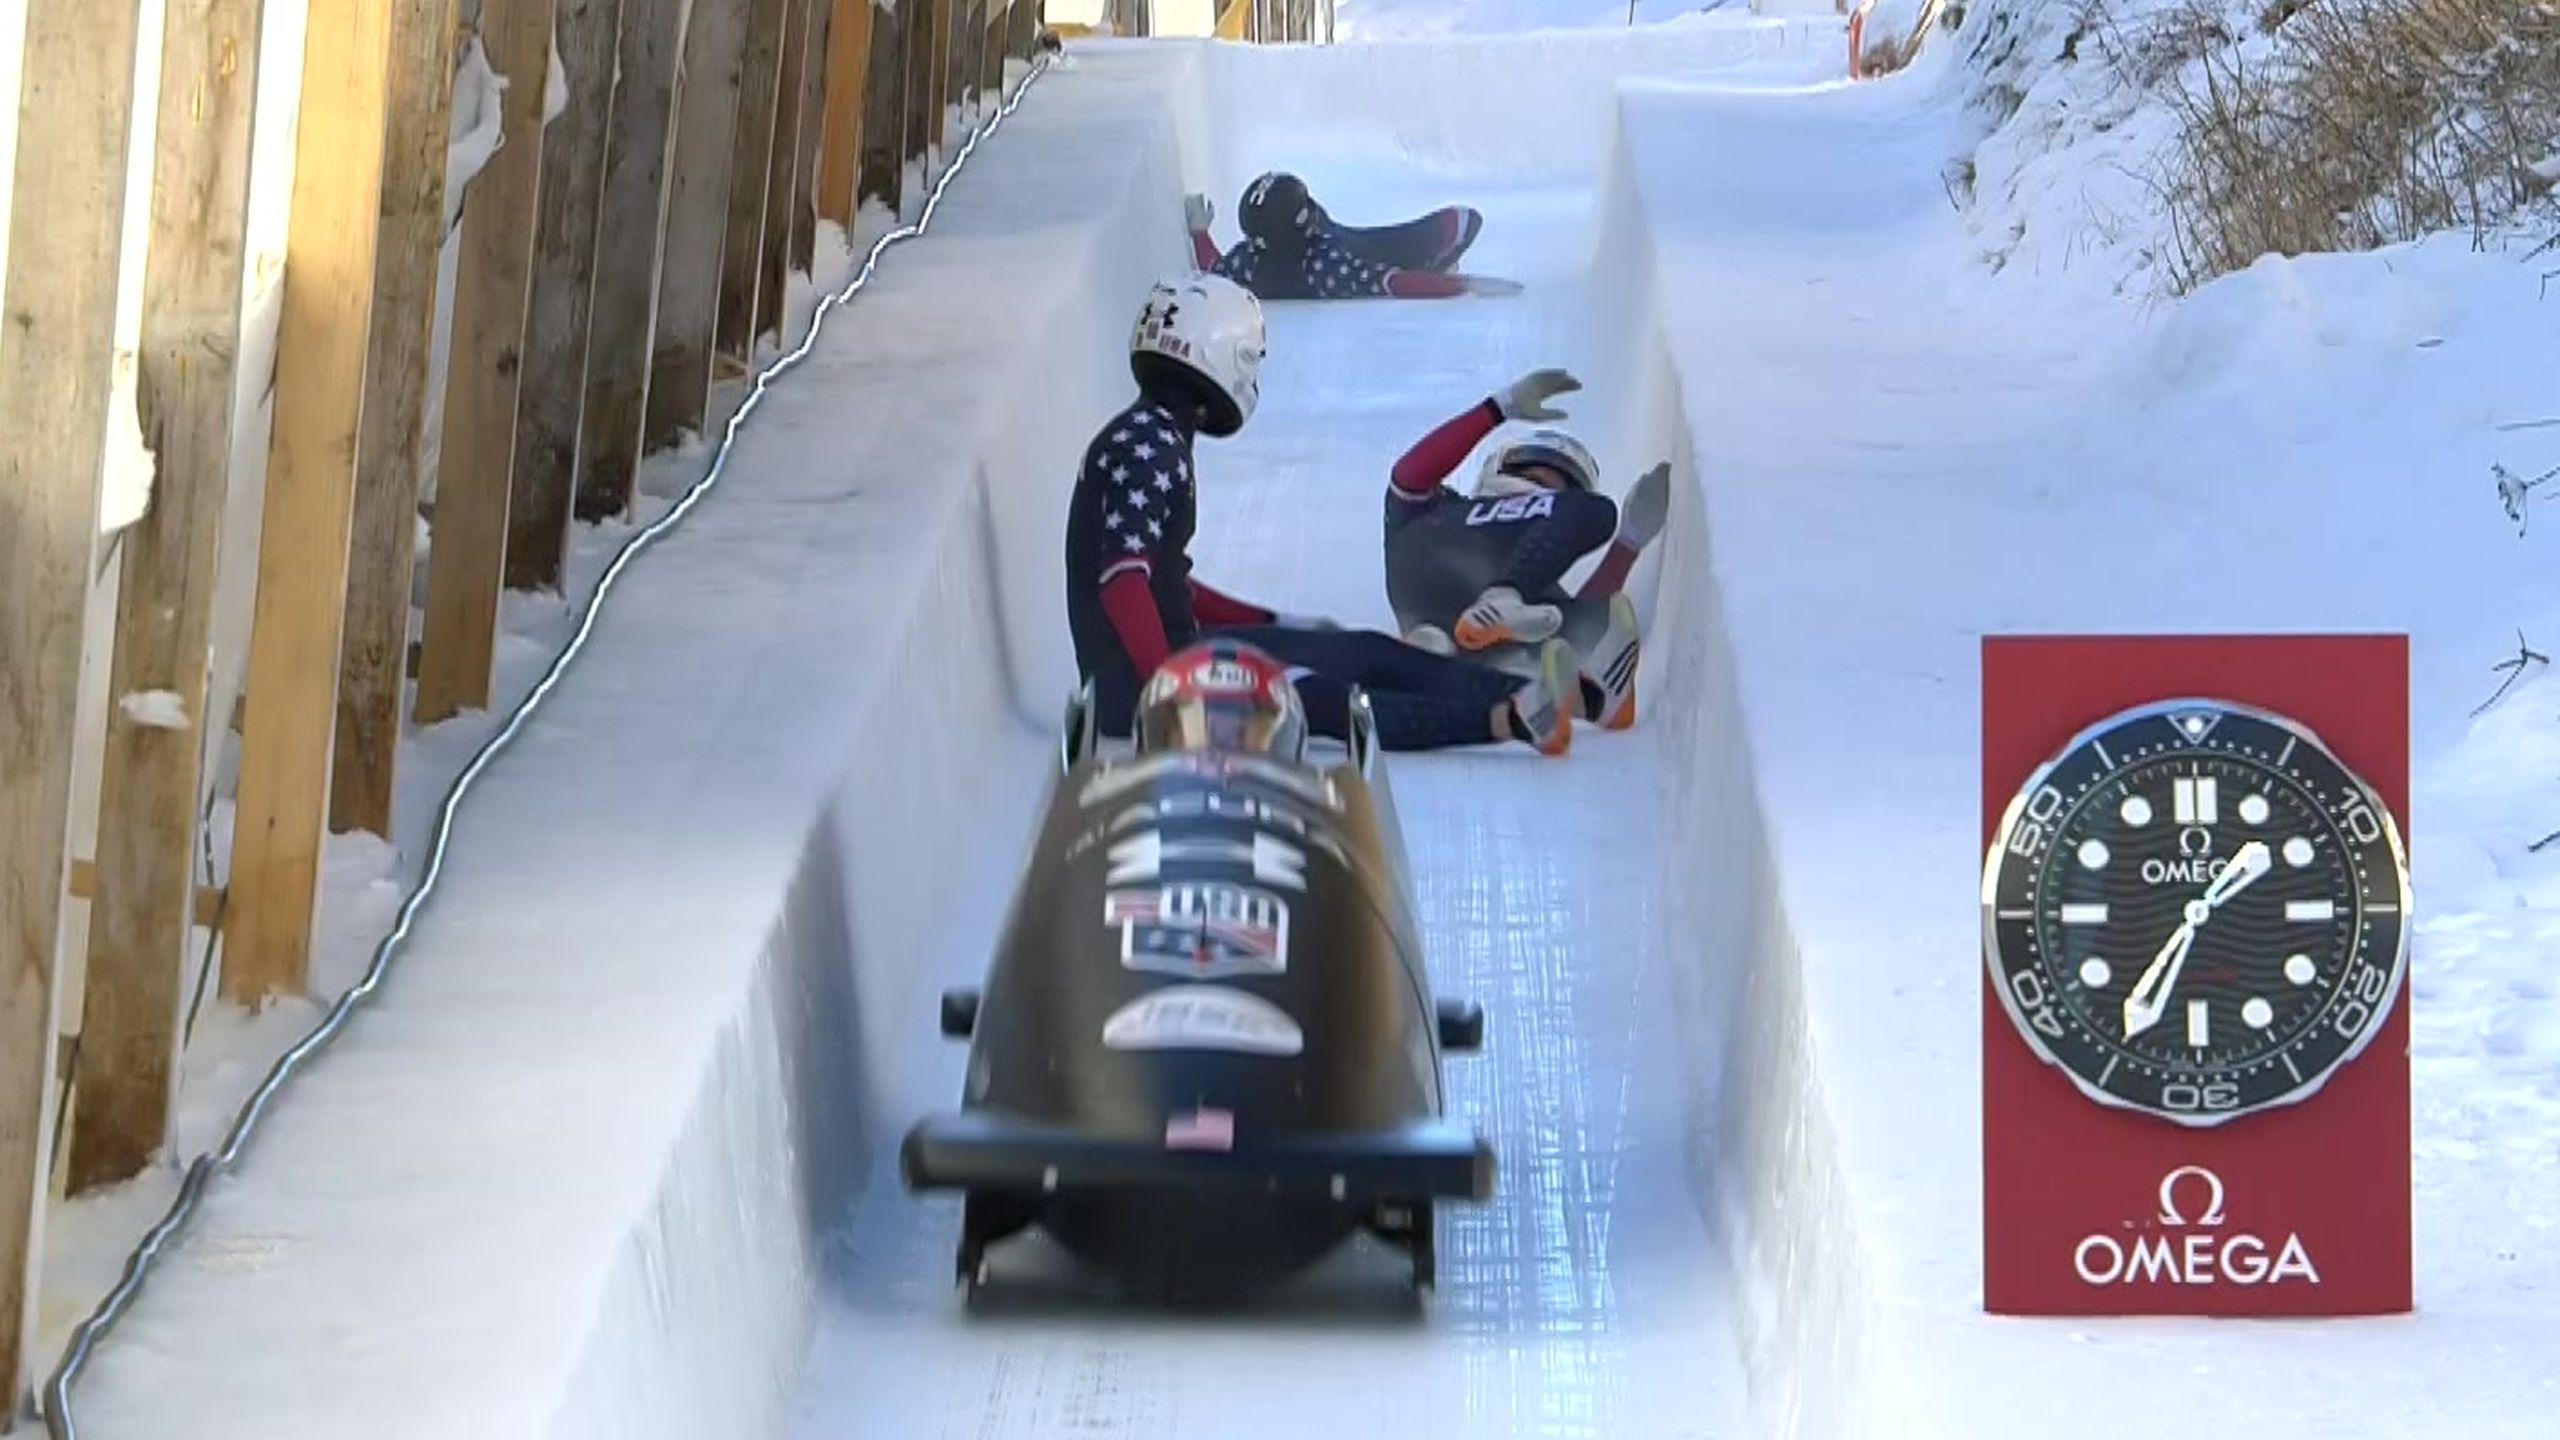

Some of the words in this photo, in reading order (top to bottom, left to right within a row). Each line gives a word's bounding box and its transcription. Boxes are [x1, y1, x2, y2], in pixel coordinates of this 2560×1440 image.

[1465, 490, 1556, 526] USA
[2009, 784, 2062, 857] 50
[2340, 787, 2380, 844] 10
[2141, 857, 2229, 884] OMEG
[2011, 969, 2064, 1038] 40
[2335, 965, 2387, 1039] 20
[2162, 1082, 2239, 1109] 30
[2074, 1232, 2321, 1284] OMEGA
